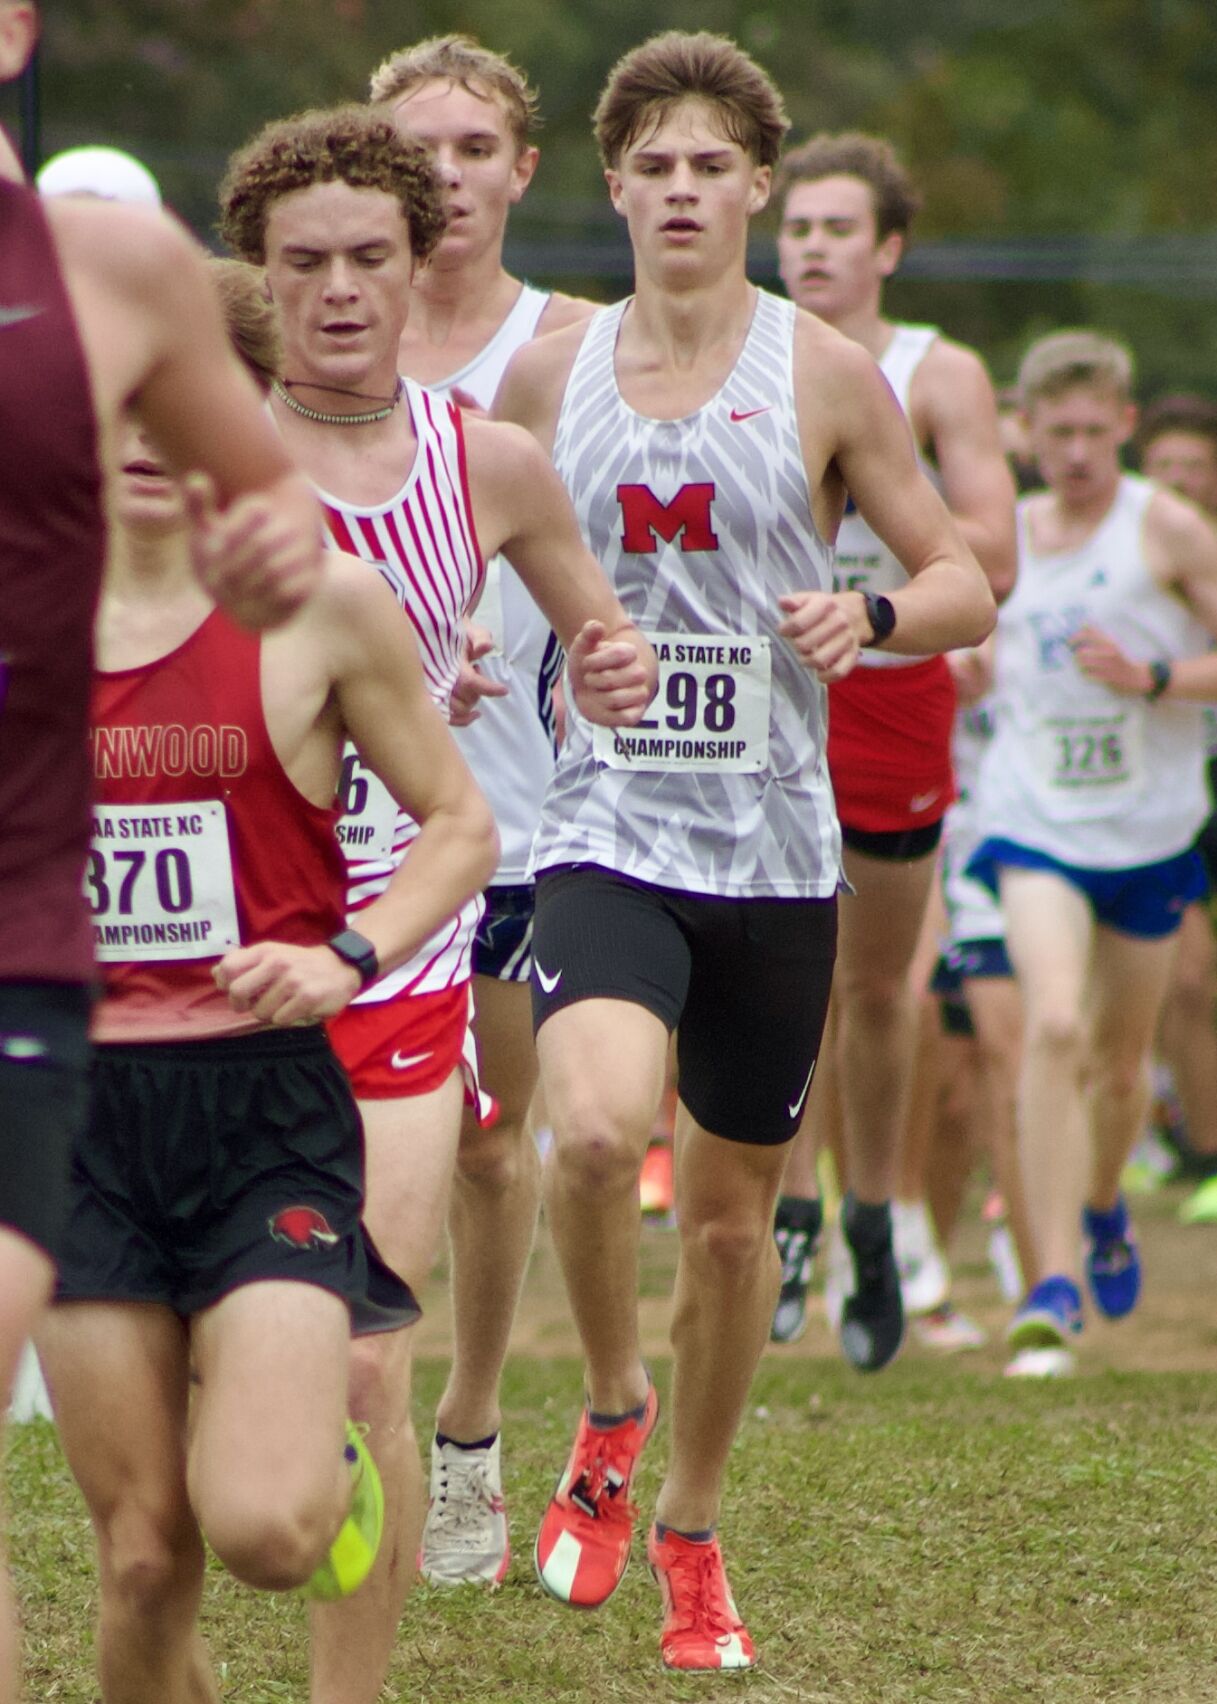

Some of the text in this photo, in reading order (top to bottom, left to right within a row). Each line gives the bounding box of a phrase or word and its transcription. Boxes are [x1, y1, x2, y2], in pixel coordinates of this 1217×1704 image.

[617, 482, 719, 554] M
[675, 644, 725, 665] STATE
[728, 647, 752, 665] XC
[627, 671, 736, 733] 98
[89, 724, 248, 779] NWOOD
[613, 737, 747, 760] CHAMPIONSHIP
[118, 817, 174, 839] STATE
[178, 814, 204, 836] XC
